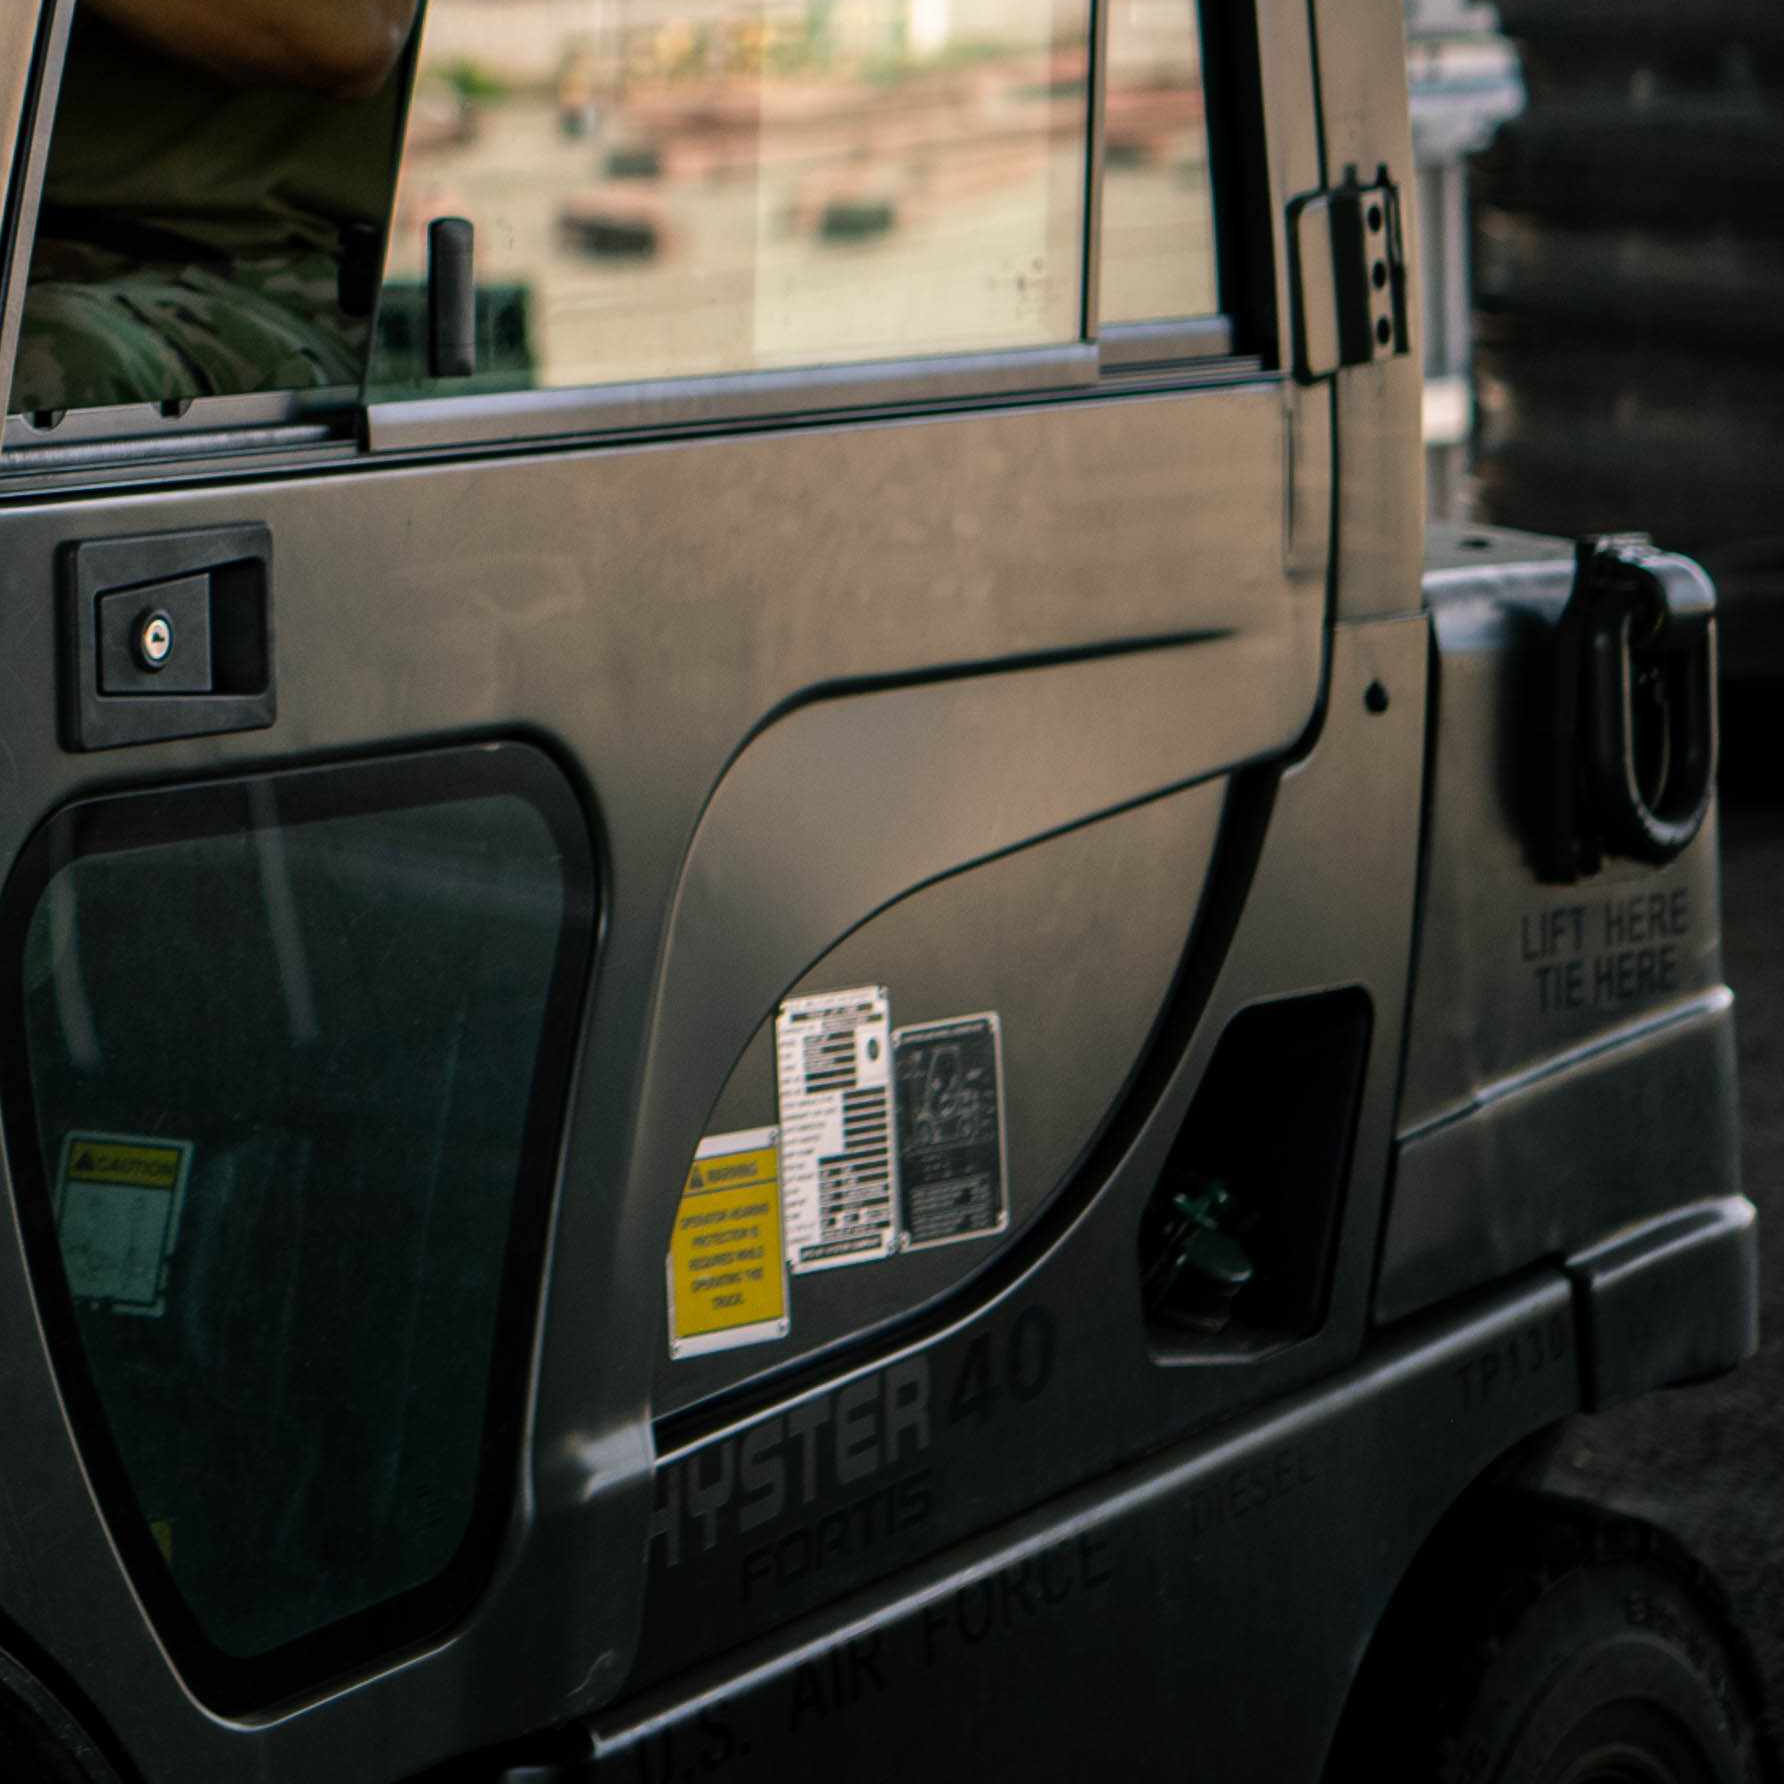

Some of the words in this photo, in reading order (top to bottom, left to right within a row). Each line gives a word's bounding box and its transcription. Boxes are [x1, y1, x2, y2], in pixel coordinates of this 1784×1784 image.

[1522, 904, 1587, 962] LIFT
[1606, 887, 1689, 946] HERE
[1535, 960, 1584, 1012] TIE
[1594, 944, 1677, 1004] HERE
[643, 1352, 932, 1569] HYSTER
[950, 1302, 1055, 1424] 40
[1191, 1446, 1317, 1537] DIESEL
[739, 1467, 933, 1606] FORTIS
[788, 1632, 887, 1733] AIR
[920, 1534, 1113, 1669] FORCE
